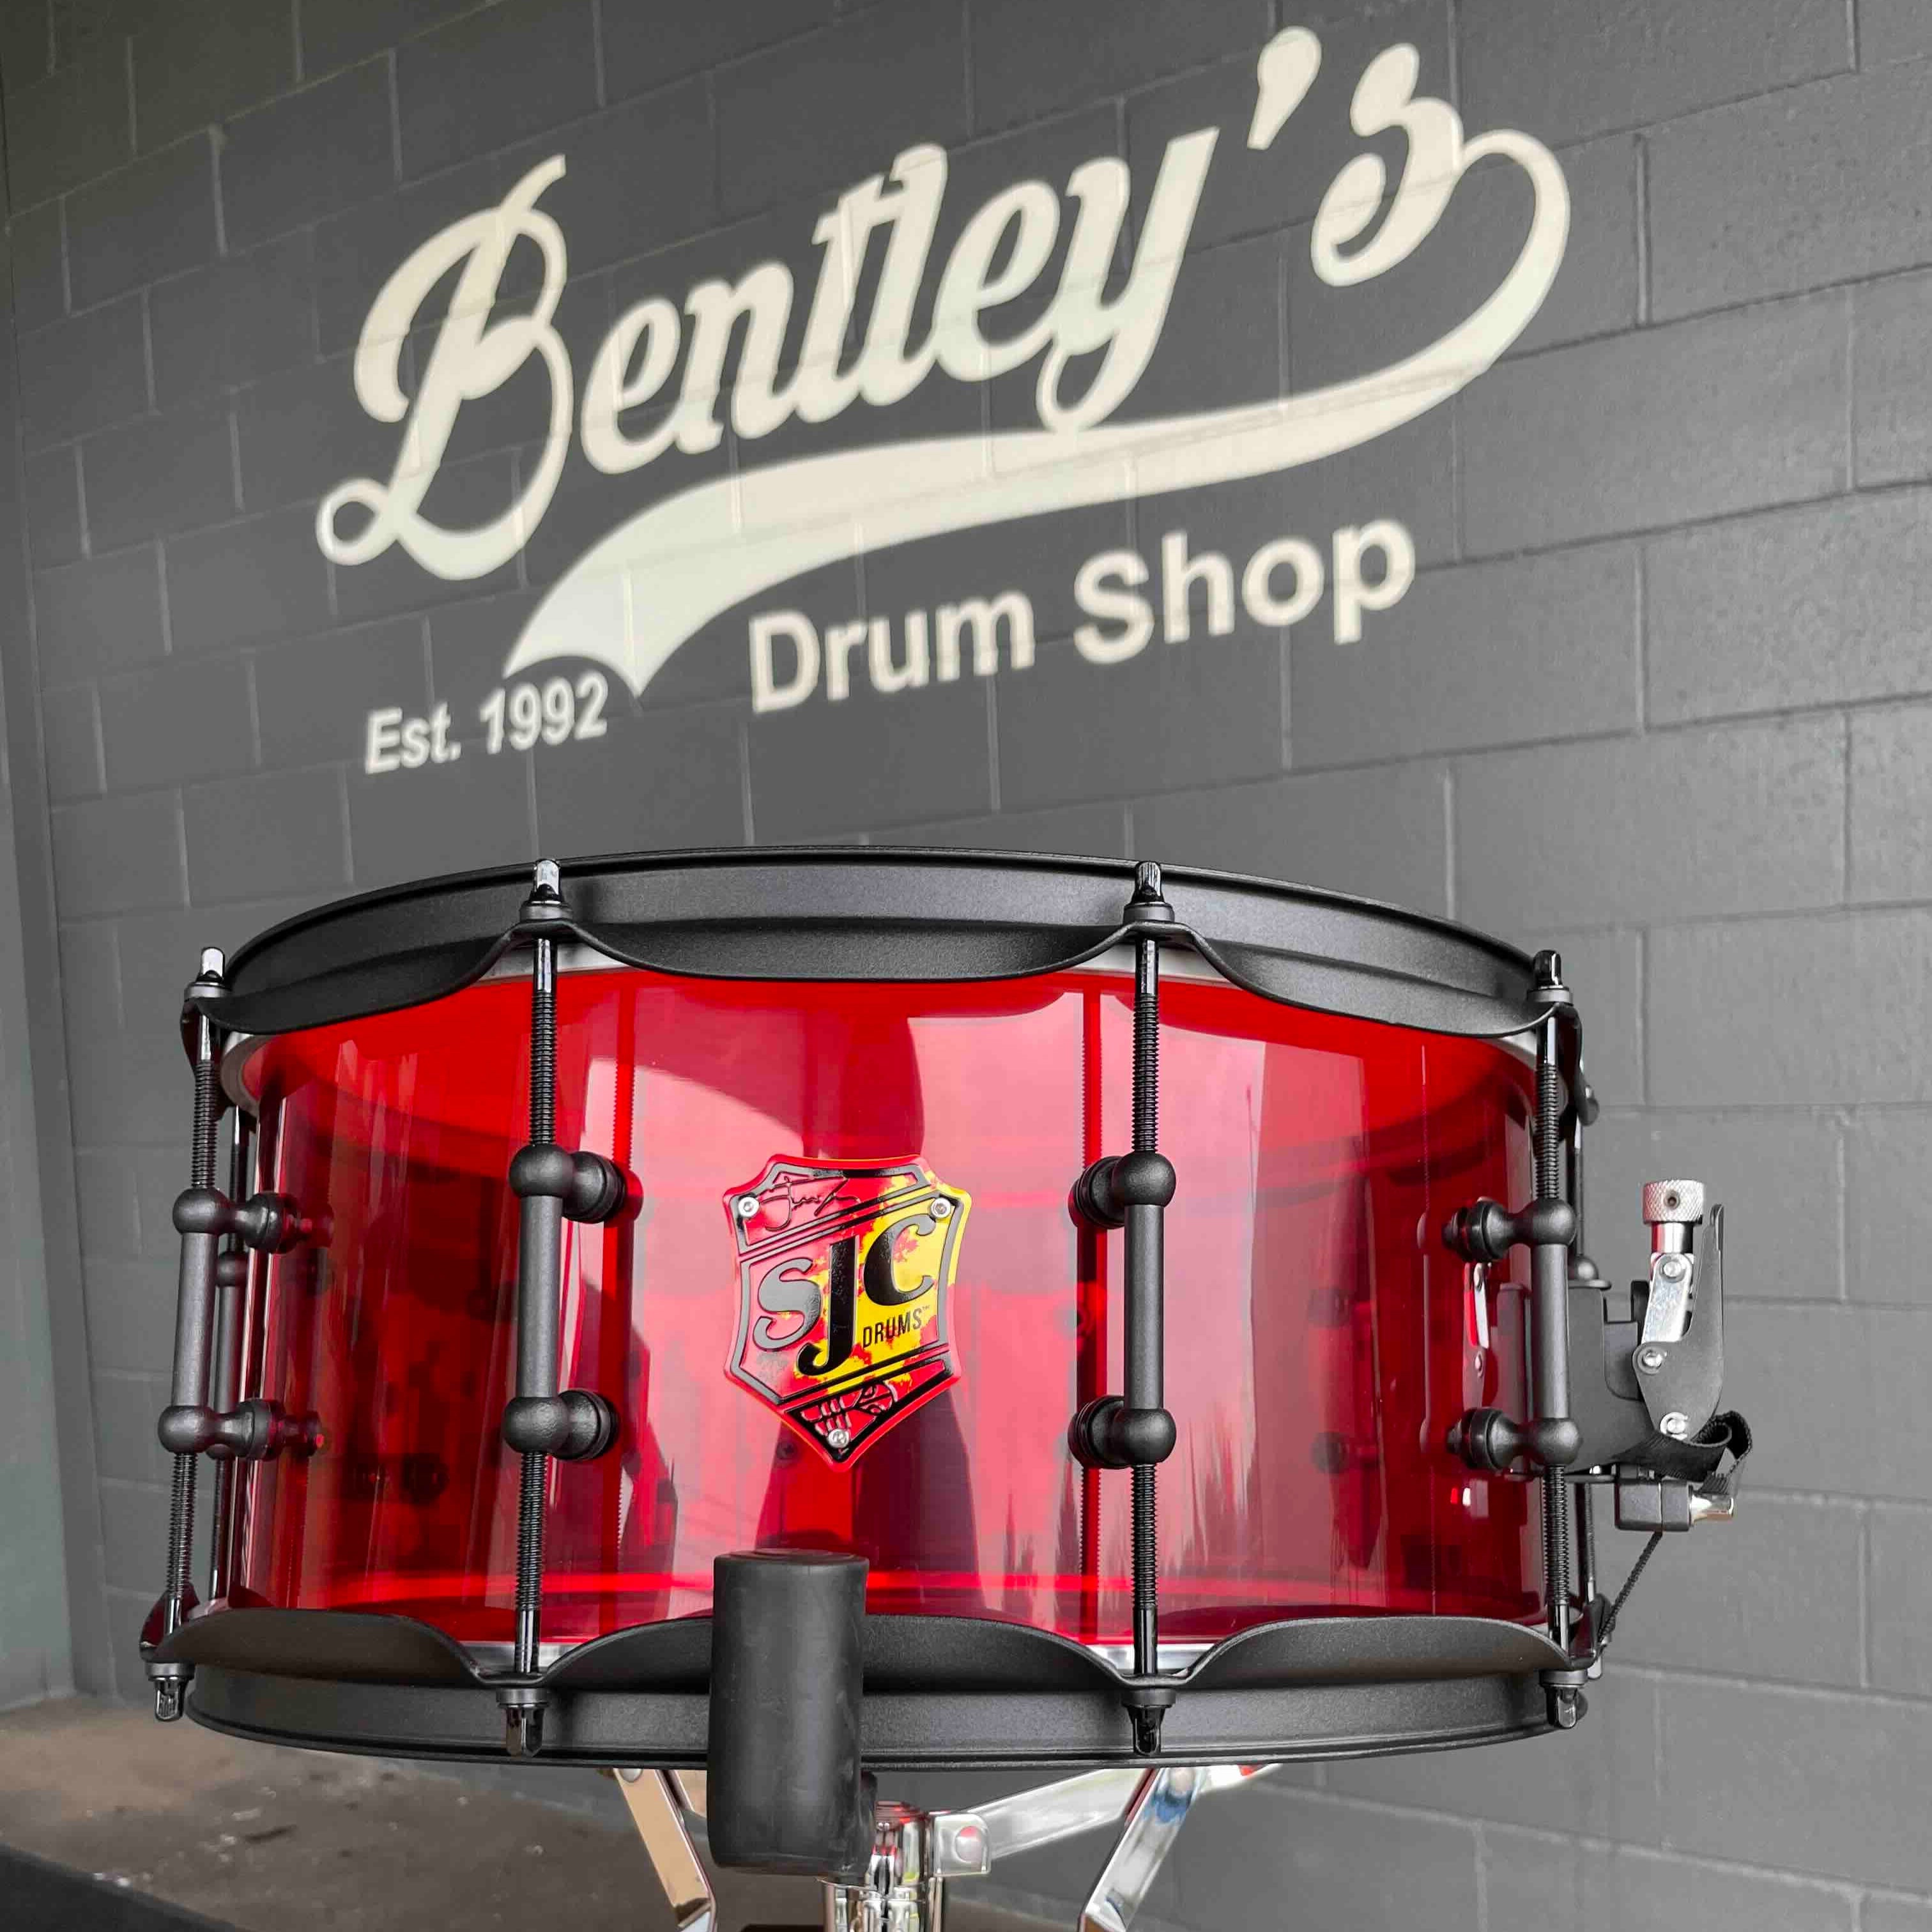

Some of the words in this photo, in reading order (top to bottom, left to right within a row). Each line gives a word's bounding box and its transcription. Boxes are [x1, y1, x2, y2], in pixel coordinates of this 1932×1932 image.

[316, 27, 1571, 581] Bentley's
[748, 592, 1036, 713] Drum
[1073, 519, 1416, 664] Shop
[364, 702, 463, 774] Est.
[479, 670, 609, 755] 1992
[752, 1213, 937, 1376] SJC
[862, 1307, 923, 1349] DRUMS
